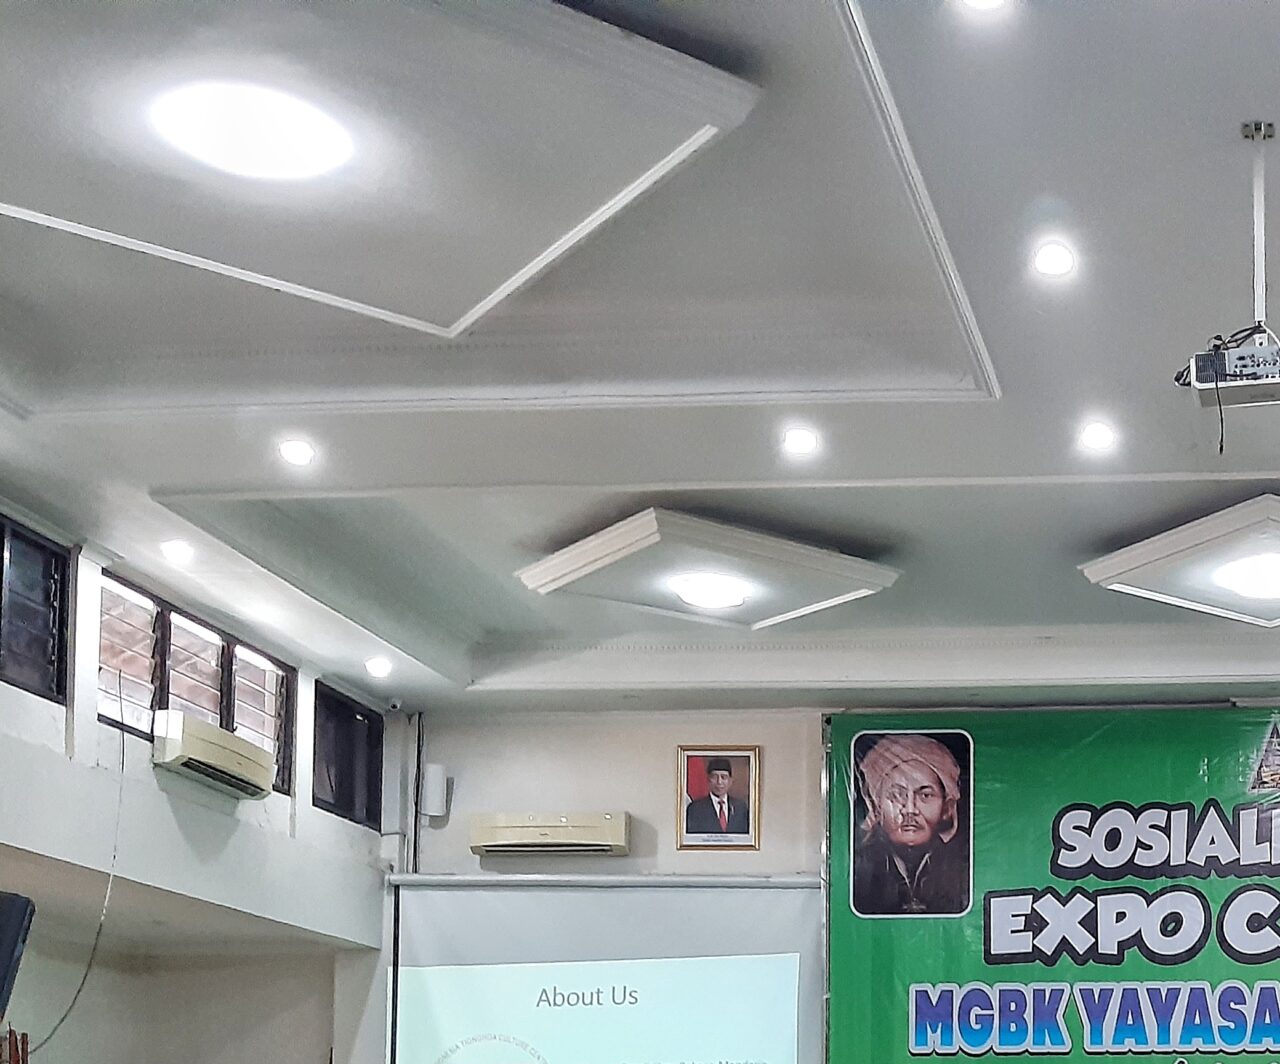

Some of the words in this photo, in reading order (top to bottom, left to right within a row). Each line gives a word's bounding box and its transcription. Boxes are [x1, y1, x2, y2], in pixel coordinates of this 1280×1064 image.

[988, 887, 1206, 958] EXPO
[536, 986, 604, 1007] About
[612, 985, 639, 1005] Us
[911, 984, 1070, 1050] MGBK
